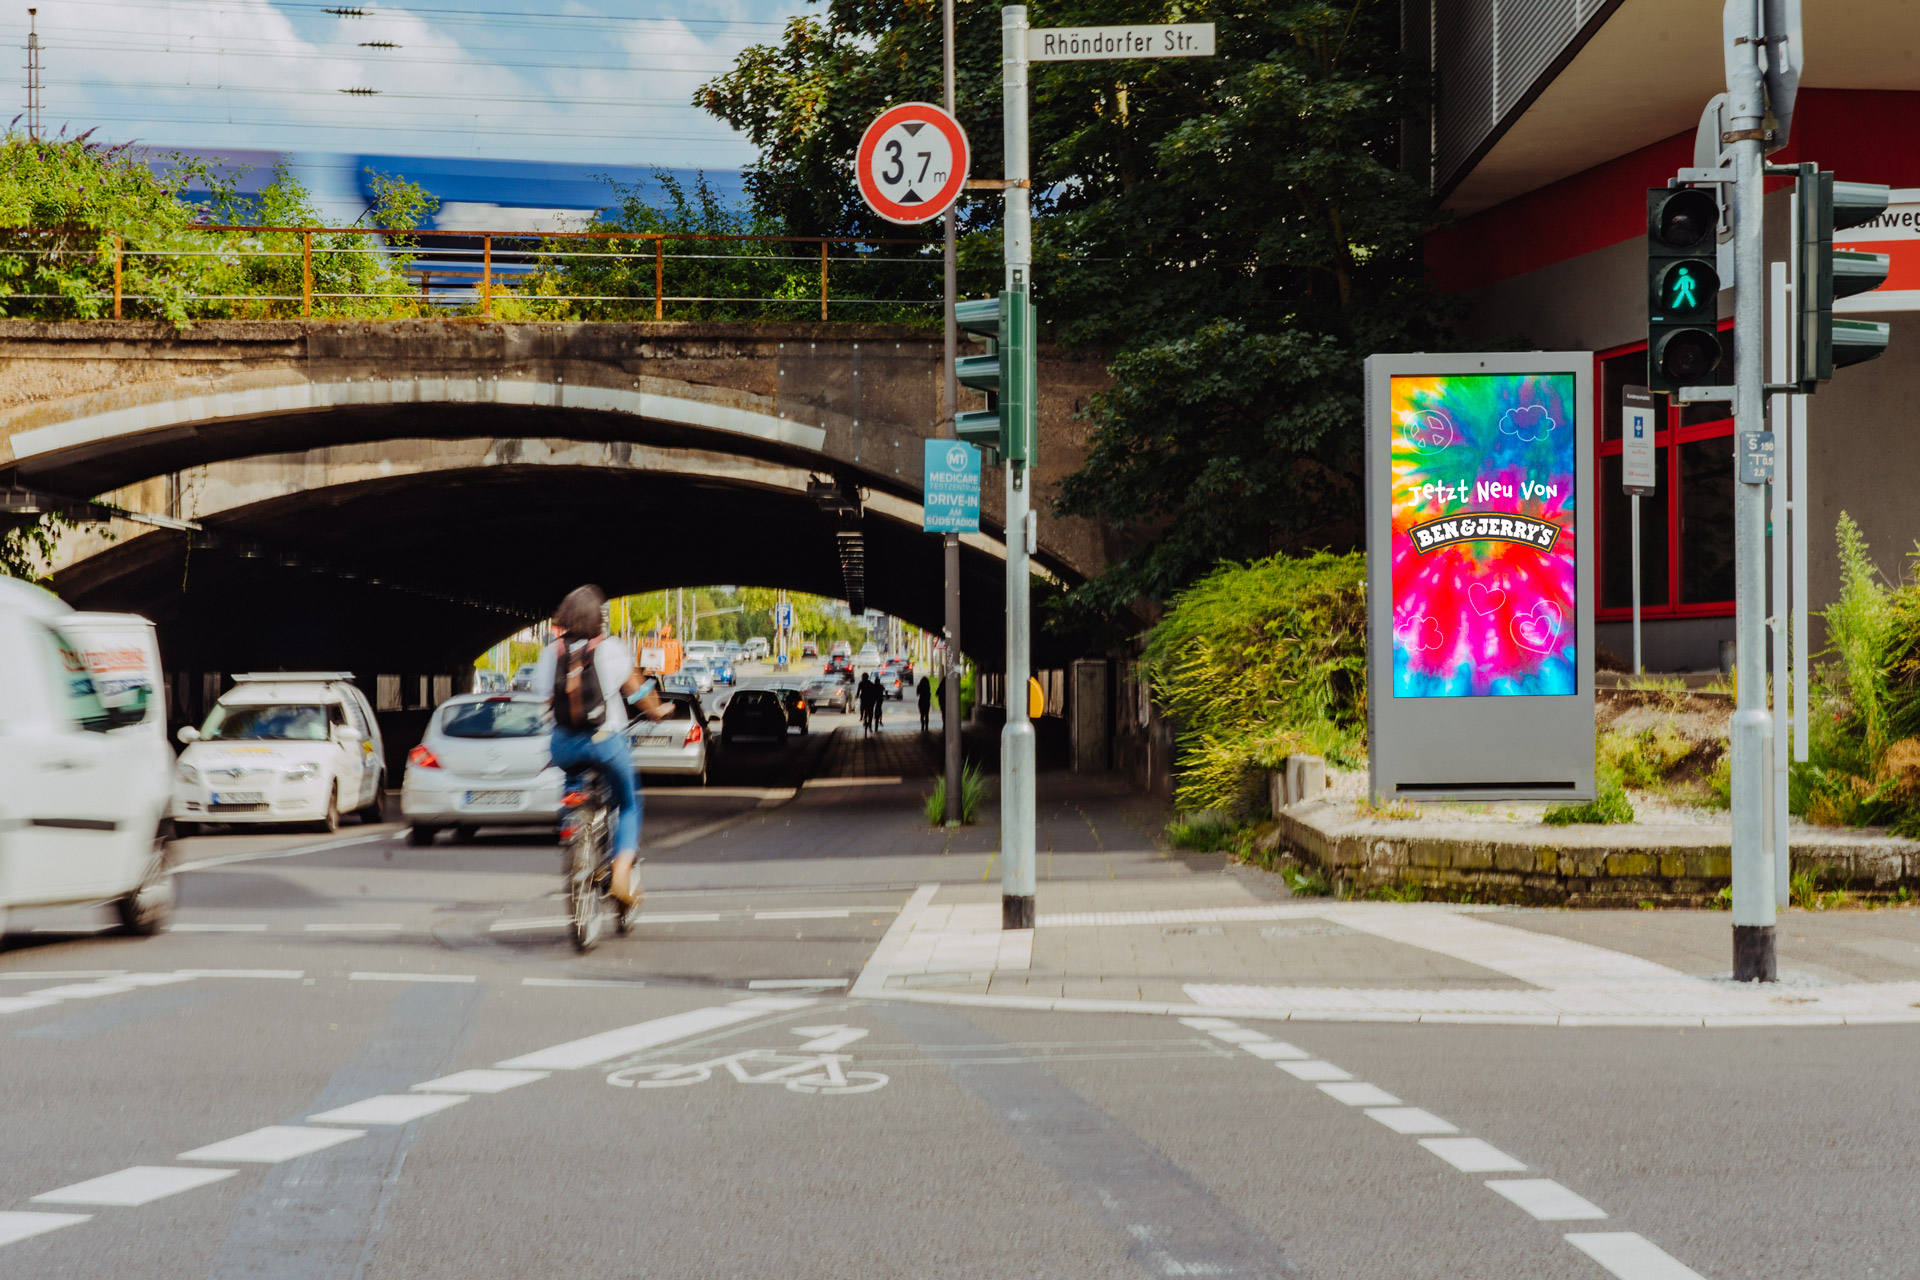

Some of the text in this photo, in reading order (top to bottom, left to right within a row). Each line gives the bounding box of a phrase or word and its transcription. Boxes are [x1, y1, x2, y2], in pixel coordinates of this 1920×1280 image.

[1044, 29, 1199, 55] Rhöndorfer Str.
[1749, 438, 1758, 450] S
[949, 454, 965, 465] MT
[930, 472, 978, 484] MEDICARE
[930, 483, 978, 492] TESTZENTRUM
[1407, 478, 1469, 507] Jetzt
[1476, 480, 1513, 503] Neu
[928, 493, 978, 508] DRIVE-IN
[948, 508, 962, 517] AM
[926, 515, 978, 529] SÜDSTADION
